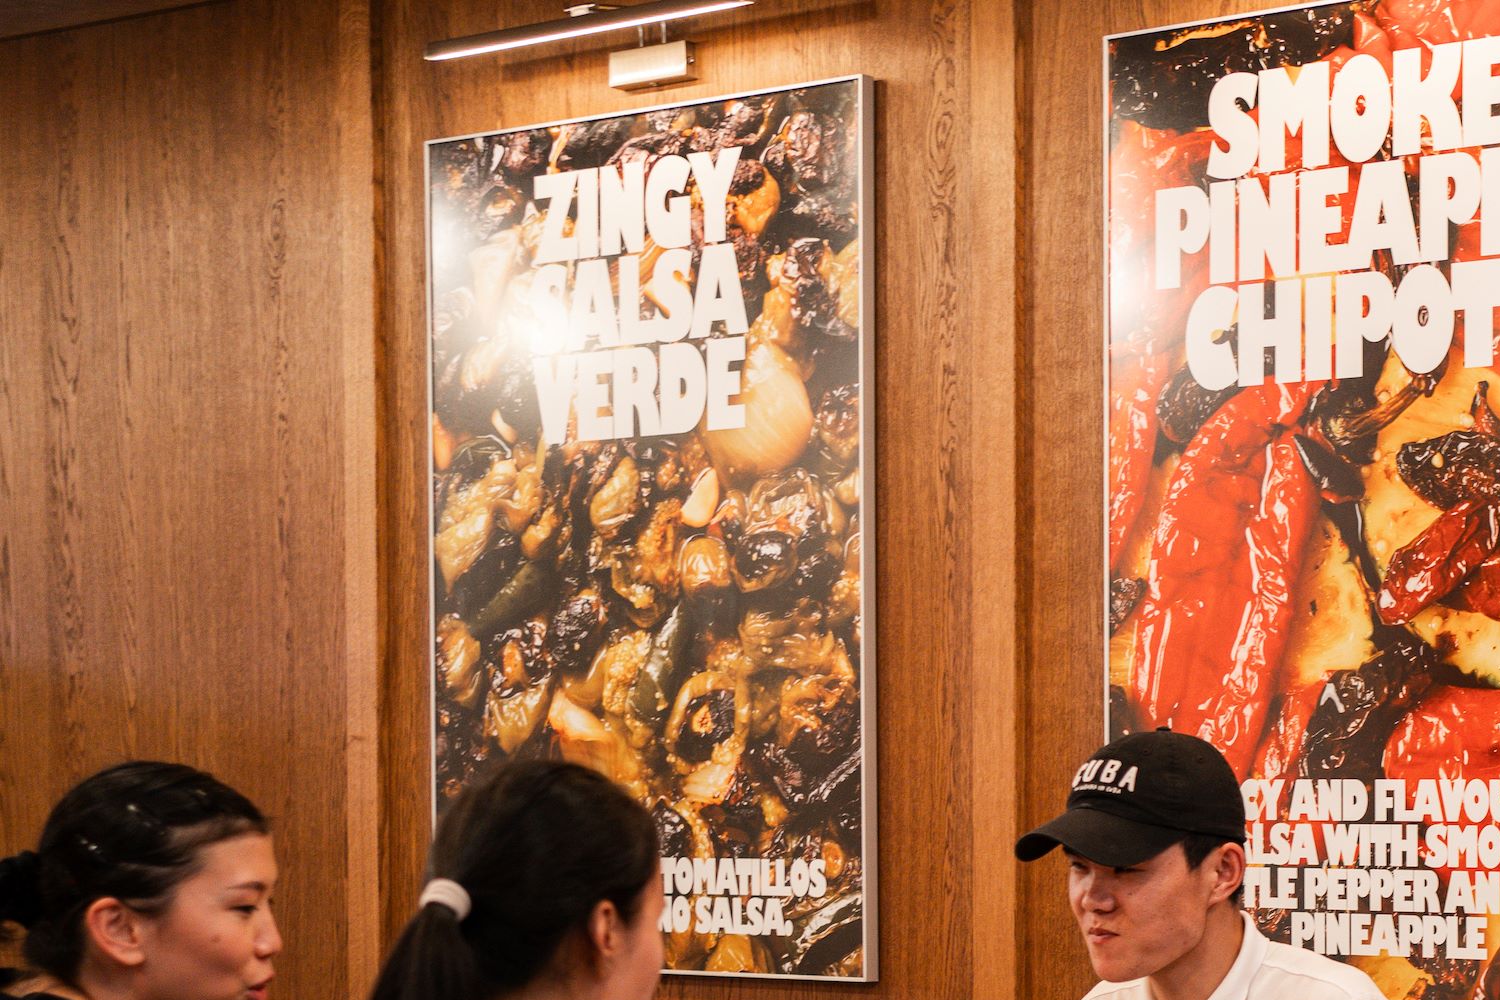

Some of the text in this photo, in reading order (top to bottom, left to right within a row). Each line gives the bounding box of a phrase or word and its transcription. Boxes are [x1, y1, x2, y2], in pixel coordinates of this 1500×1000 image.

[533, 146, 744, 266] ZINGY
[528, 242, 749, 354] SALSA
[532, 336, 747, 446] VERDE
[1289, 779, 1369, 822] AND
[1322, 824, 1419, 868] WITH
[660, 857, 827, 898] TOMATILLOS
[1304, 868, 1440, 914] PEPPER
[694, 896, 794, 937] SALSA.
[1291, 912, 1488, 960] PINEAPPLE
